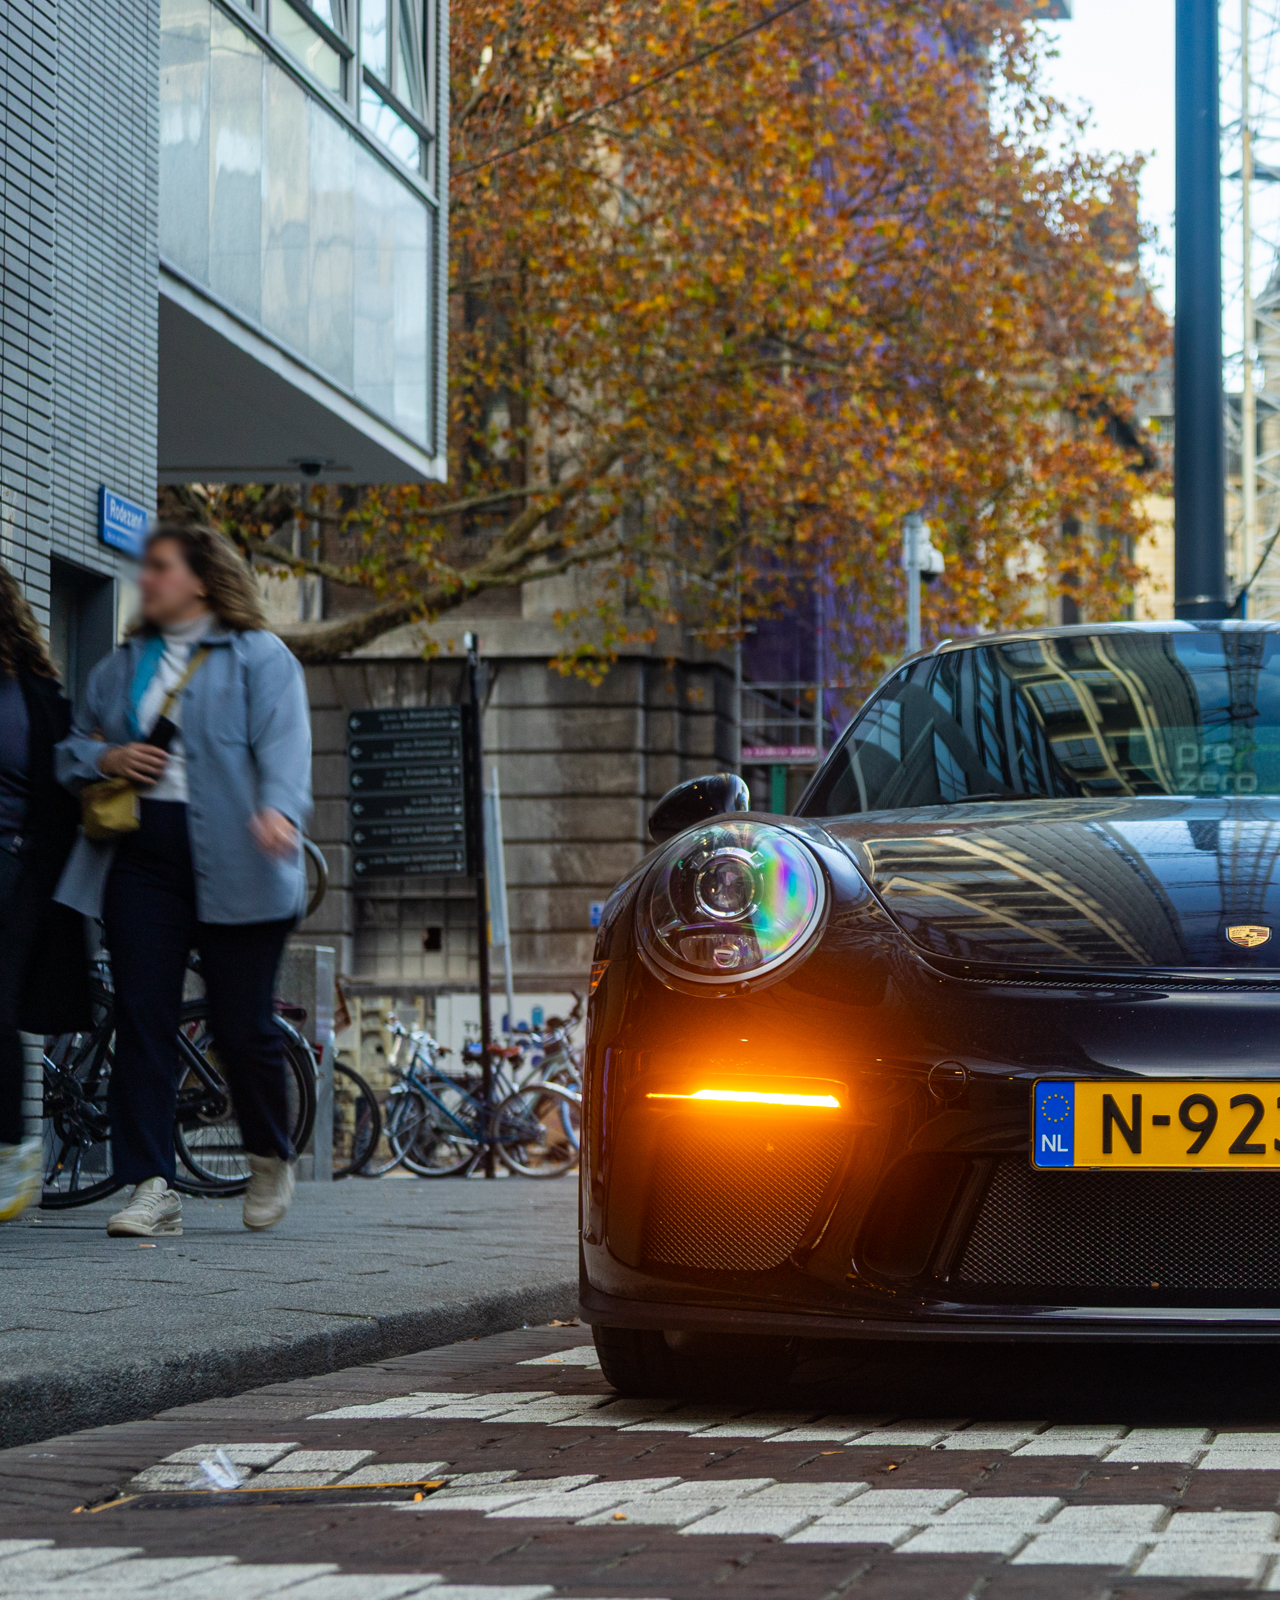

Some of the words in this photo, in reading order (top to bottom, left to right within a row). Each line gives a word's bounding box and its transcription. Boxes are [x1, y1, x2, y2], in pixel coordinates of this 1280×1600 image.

[109, 498, 143, 529] Rodezand
[1176, 741, 1235, 769] pre
[1178, 772, 1258, 793] zero
[1041, 1134, 1069, 1153] NL
